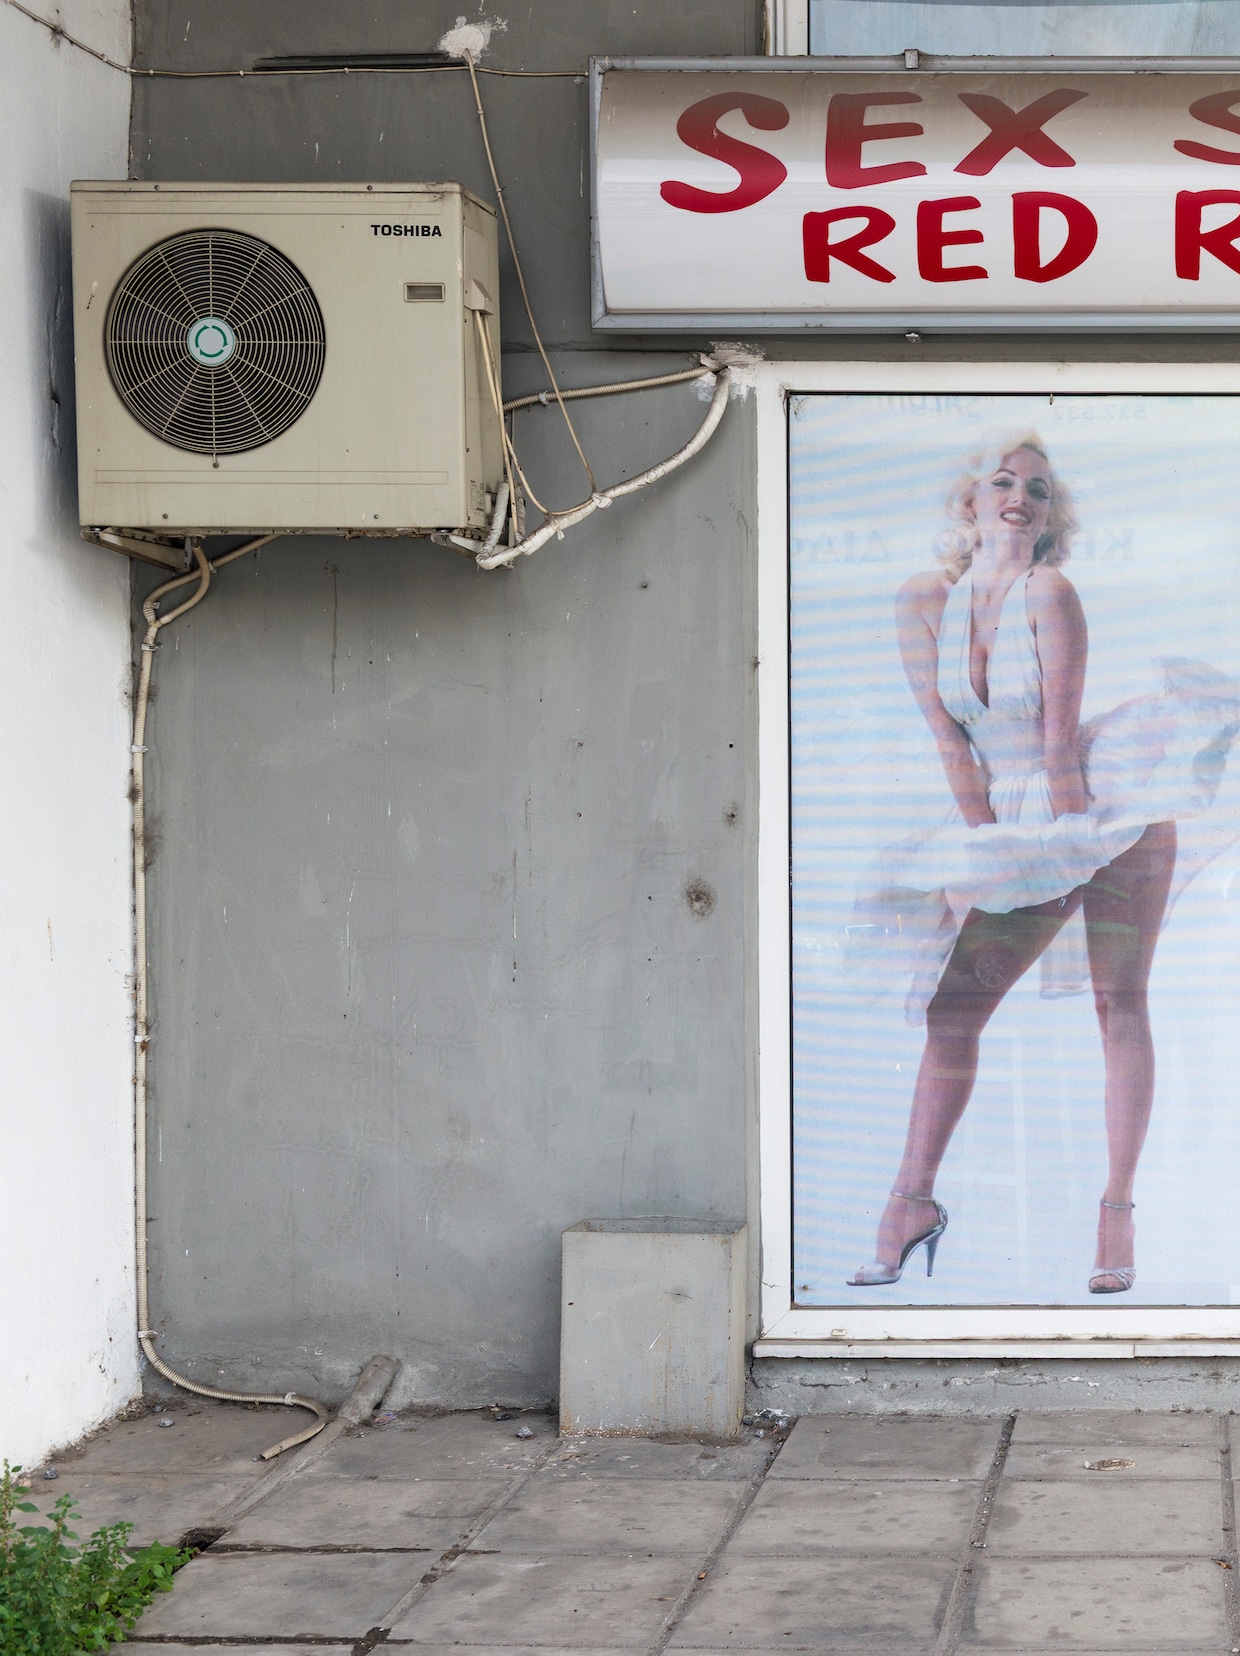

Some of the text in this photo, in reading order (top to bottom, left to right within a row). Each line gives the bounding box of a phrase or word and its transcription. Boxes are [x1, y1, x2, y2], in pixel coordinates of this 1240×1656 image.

[660, 88, 1088, 214] SEX
[370, 224, 442, 237] TOSHIBA
[802, 191, 1098, 284] RED
